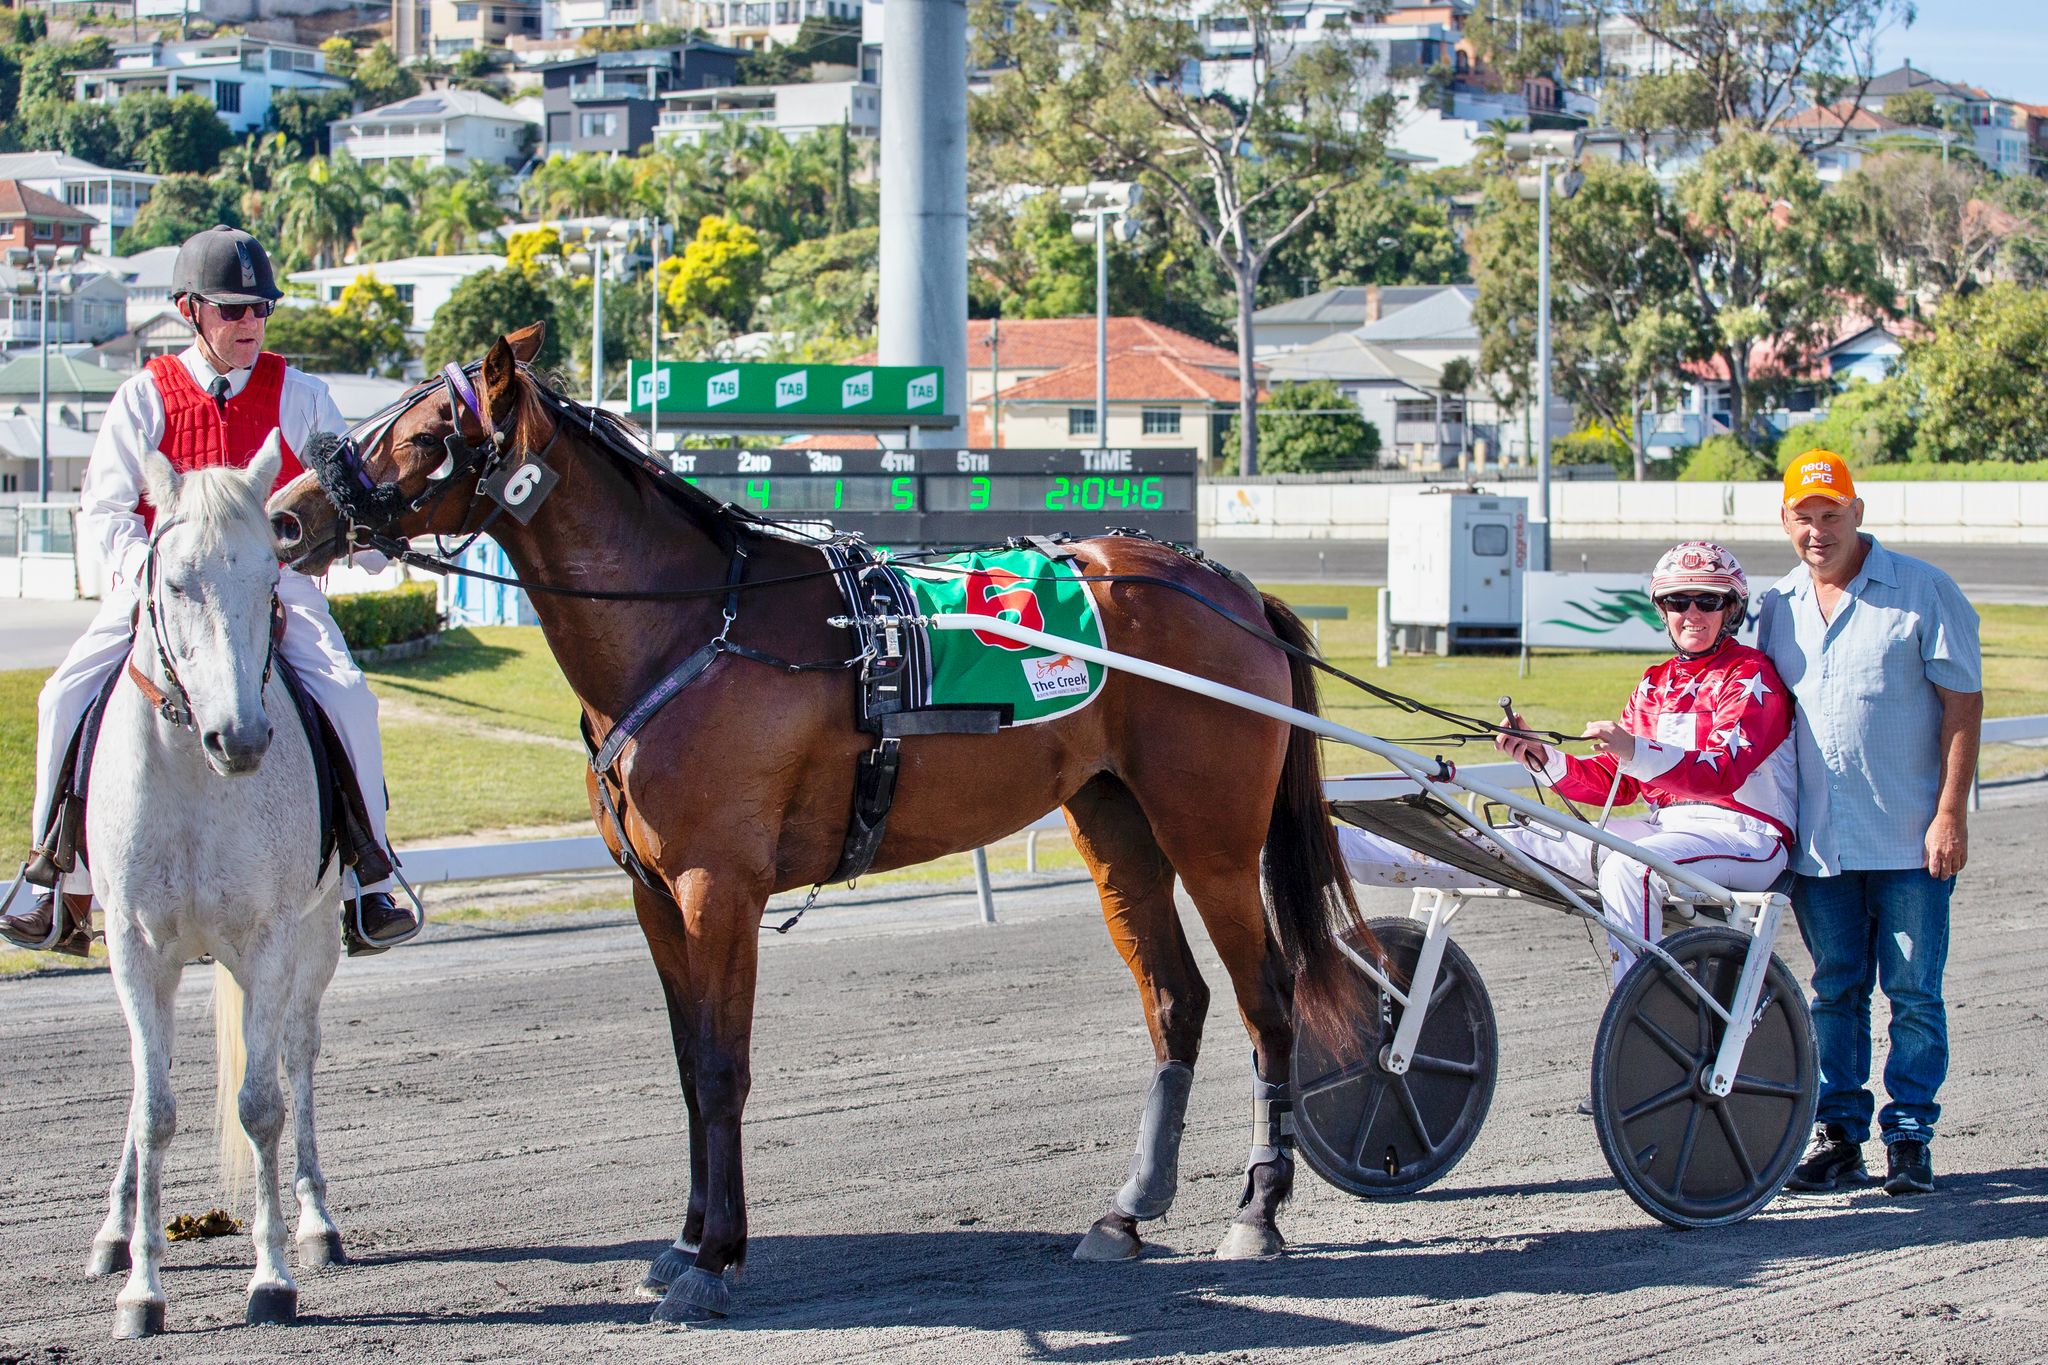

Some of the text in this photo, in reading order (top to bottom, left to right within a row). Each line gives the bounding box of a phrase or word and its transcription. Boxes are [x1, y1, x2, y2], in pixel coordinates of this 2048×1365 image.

[711, 381, 736, 396] TAB
[780, 383, 803, 396] TAB
[846, 383, 869, 397] TAB
[911, 385, 934, 398] TAB
[669, 450, 1133, 473] 1ST 2ND 3RD 4TH 5TH TIME
[1801, 461, 1832, 474] neds
[503, 463, 542, 506] 6
[1801, 472, 1833, 486] APG
[747, 476, 1164, 511] 4 1 5 3 2:04:6
[966, 567, 1045, 652] 6
[1032, 681, 1056, 692] The
[1056, 672, 1087, 688] Creek
